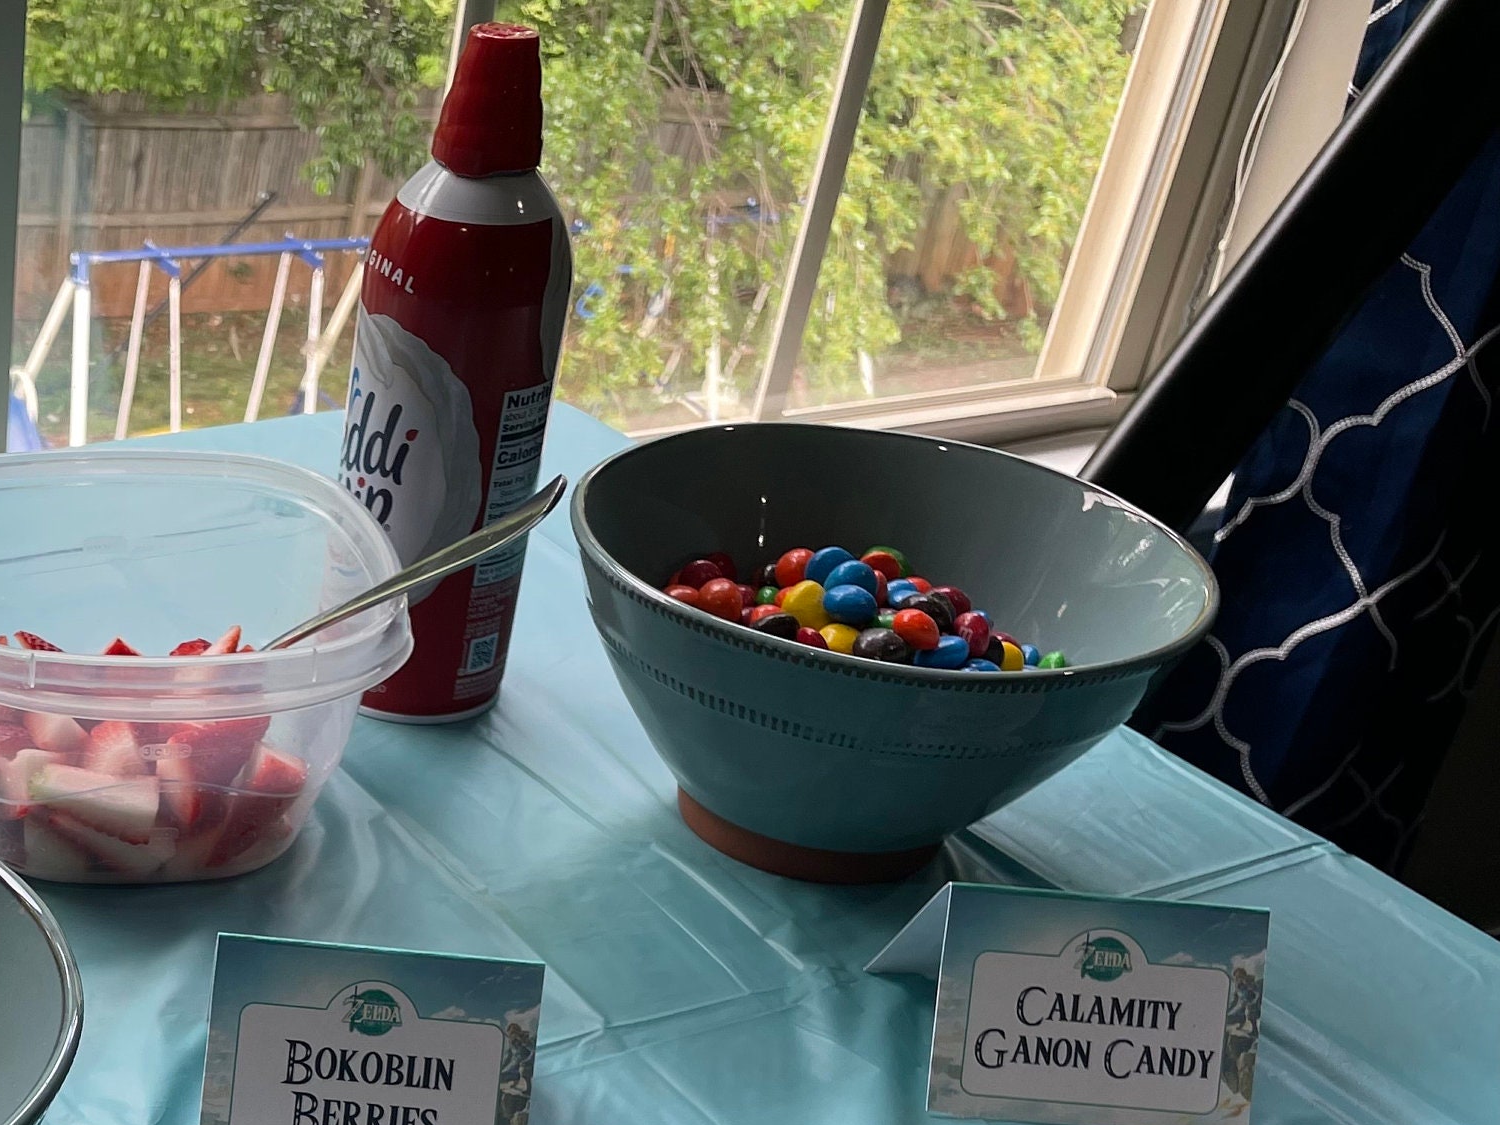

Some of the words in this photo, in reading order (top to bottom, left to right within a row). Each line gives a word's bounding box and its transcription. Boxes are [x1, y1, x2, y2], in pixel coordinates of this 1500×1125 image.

[368, 249, 414, 294] GINAL
[338, 391, 419, 486] ddi
[342, 998, 402, 1026] ZELDA
[1016, 986, 1182, 1031] CALAMITY
[281, 1038, 455, 1091] BOKOBLIN
[974, 1028, 1092, 1069] GANON
[1104, 1039, 1215, 1079] CANDY
